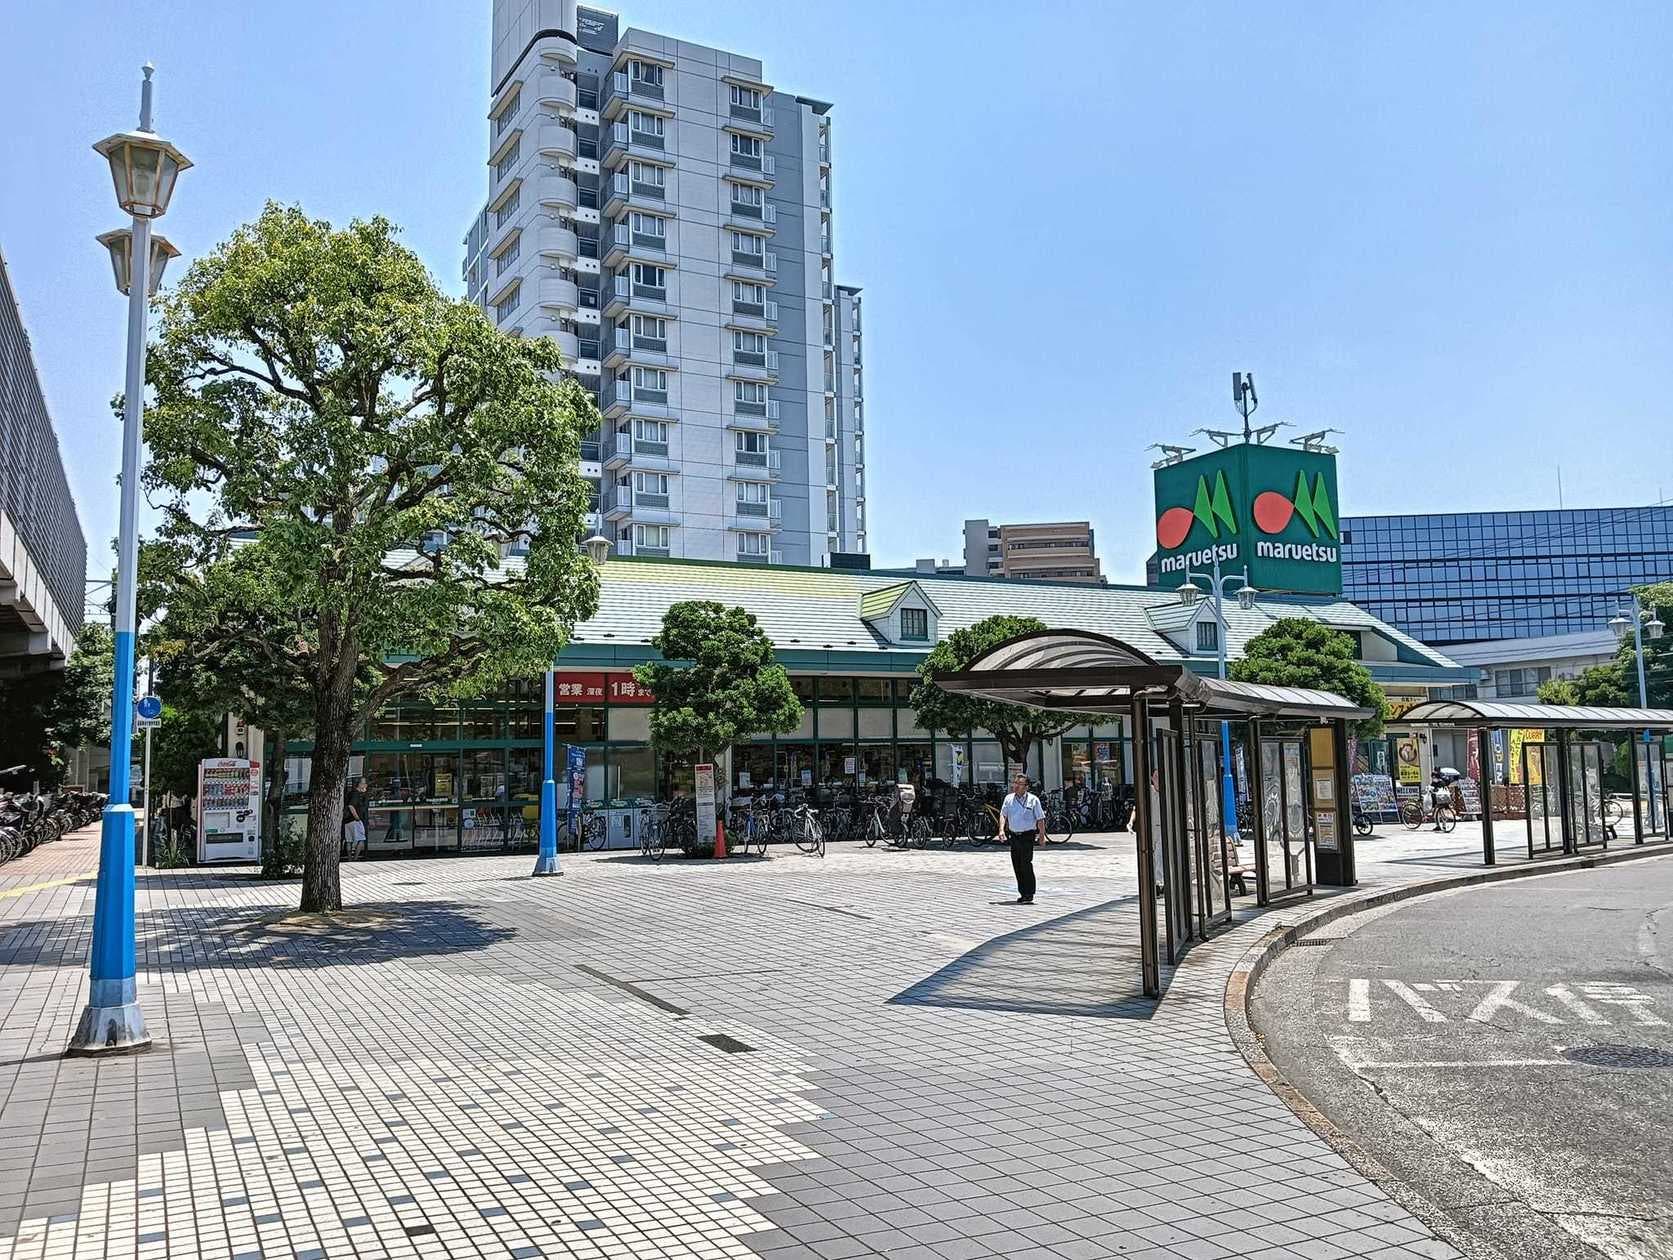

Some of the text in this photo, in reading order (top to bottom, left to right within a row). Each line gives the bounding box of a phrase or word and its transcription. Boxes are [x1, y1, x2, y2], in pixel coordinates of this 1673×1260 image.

[1161, 543, 1238, 573] maruetsu
[1257, 541, 1337, 563] maruetsu
[559, 683, 583, 696] 営業
[1494, 744, 1504, 782] OPEN
